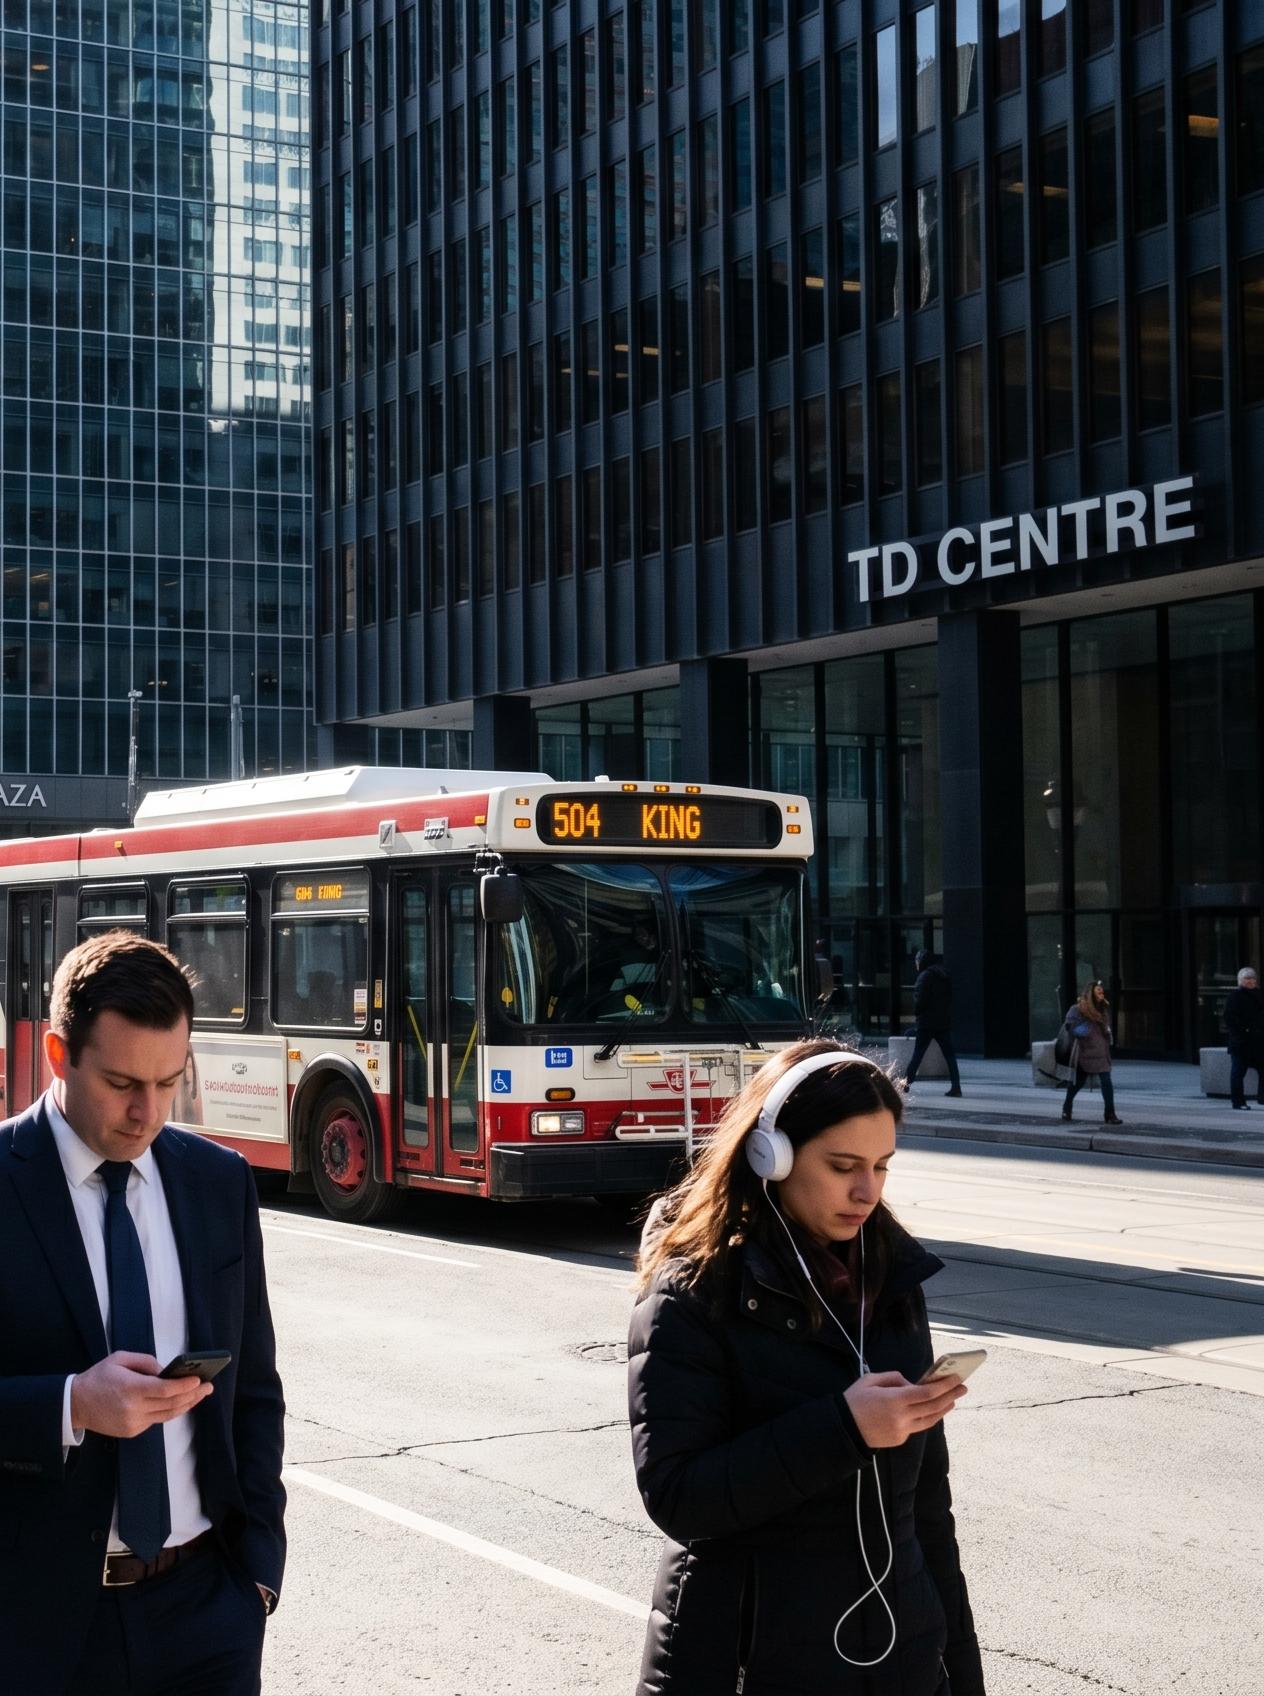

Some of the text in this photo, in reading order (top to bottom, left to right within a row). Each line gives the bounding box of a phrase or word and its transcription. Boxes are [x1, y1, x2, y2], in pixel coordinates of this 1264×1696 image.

[848, 476, 1195, 602] TD CENTRE
[554, 803, 701, 839] 504 KING
